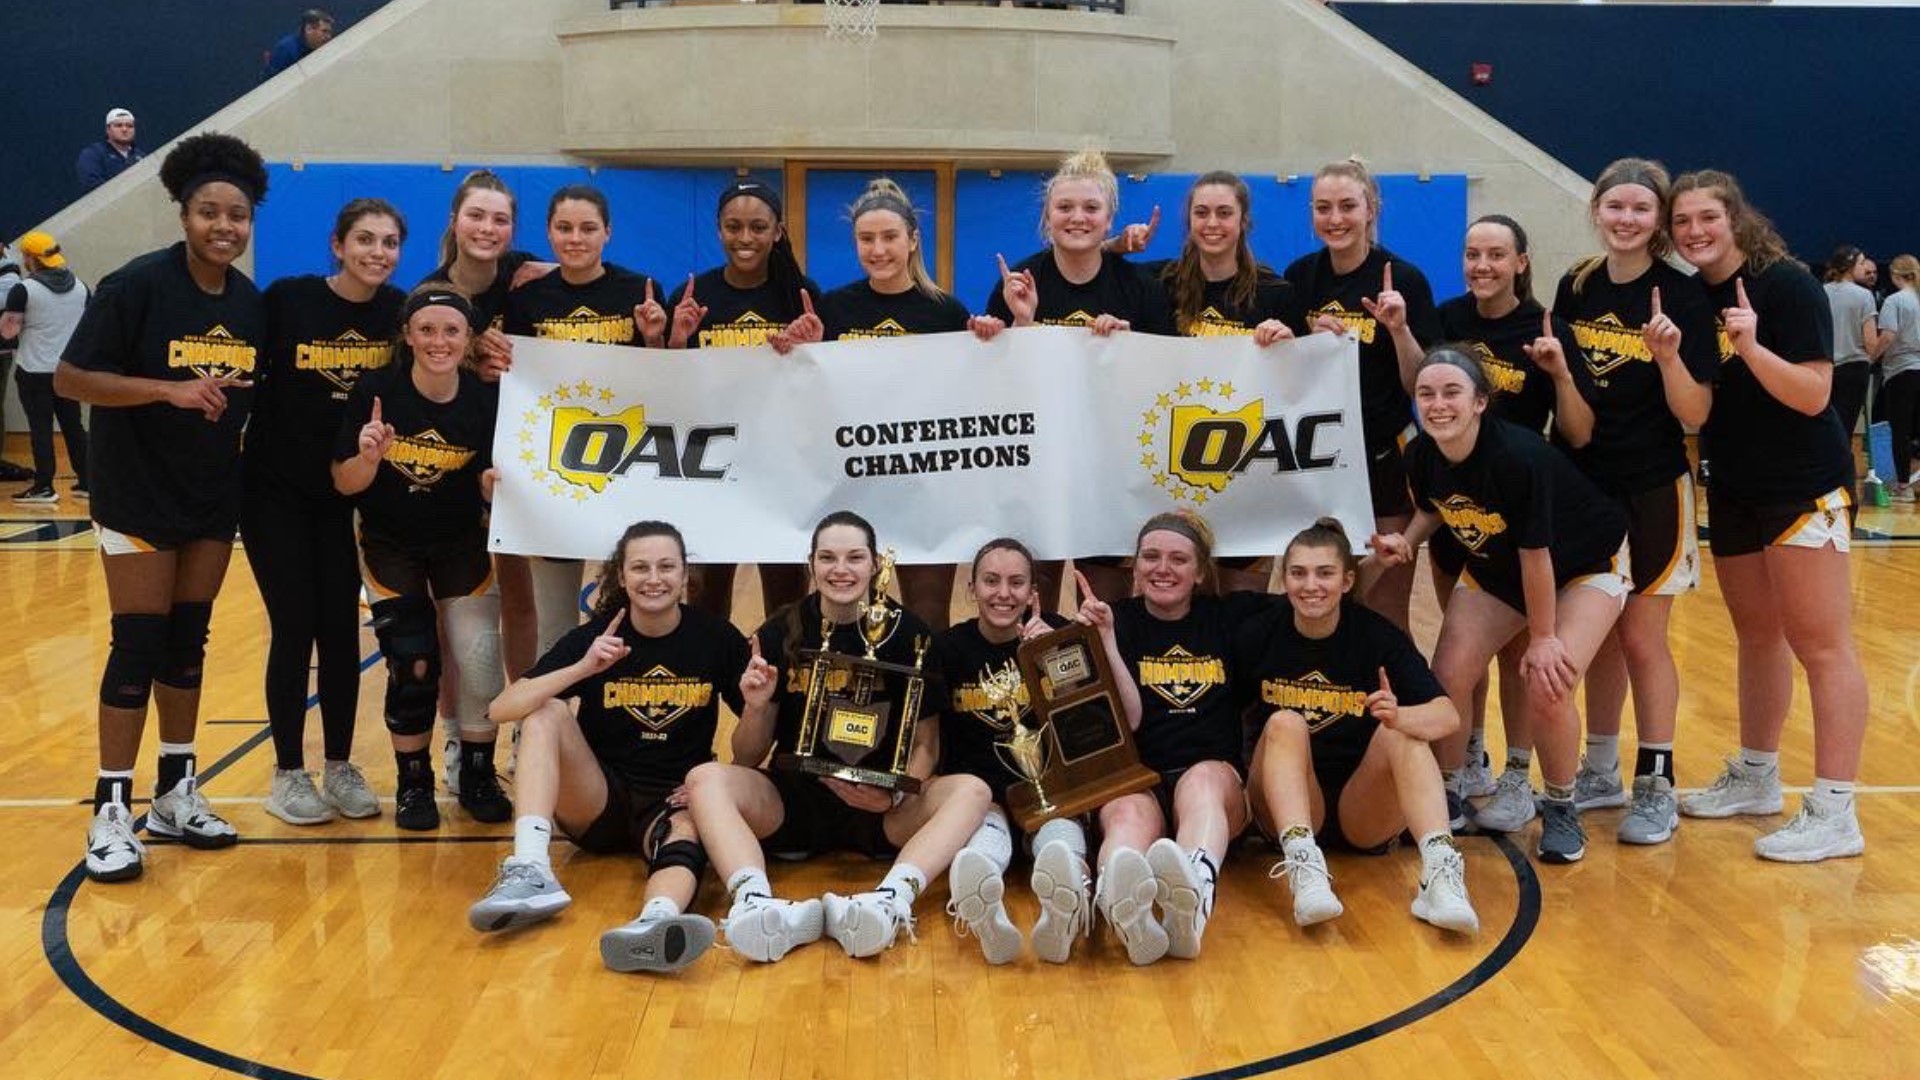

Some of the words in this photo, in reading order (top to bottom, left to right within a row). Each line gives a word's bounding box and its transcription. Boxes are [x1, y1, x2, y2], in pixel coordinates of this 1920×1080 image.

[168, 340, 257, 373] CHAMPIONS
[835, 413, 1035, 447] CONFERENCE
[1180, 410, 1343, 473] OAC
[560, 422, 738, 481] OAC
[844, 444, 1031, 478] CHAMPIONS
[603, 681, 713, 708] CHAMPIONS
[1261, 679, 1367, 717] CHAMPIONS
[846, 722, 869, 735] OAC
